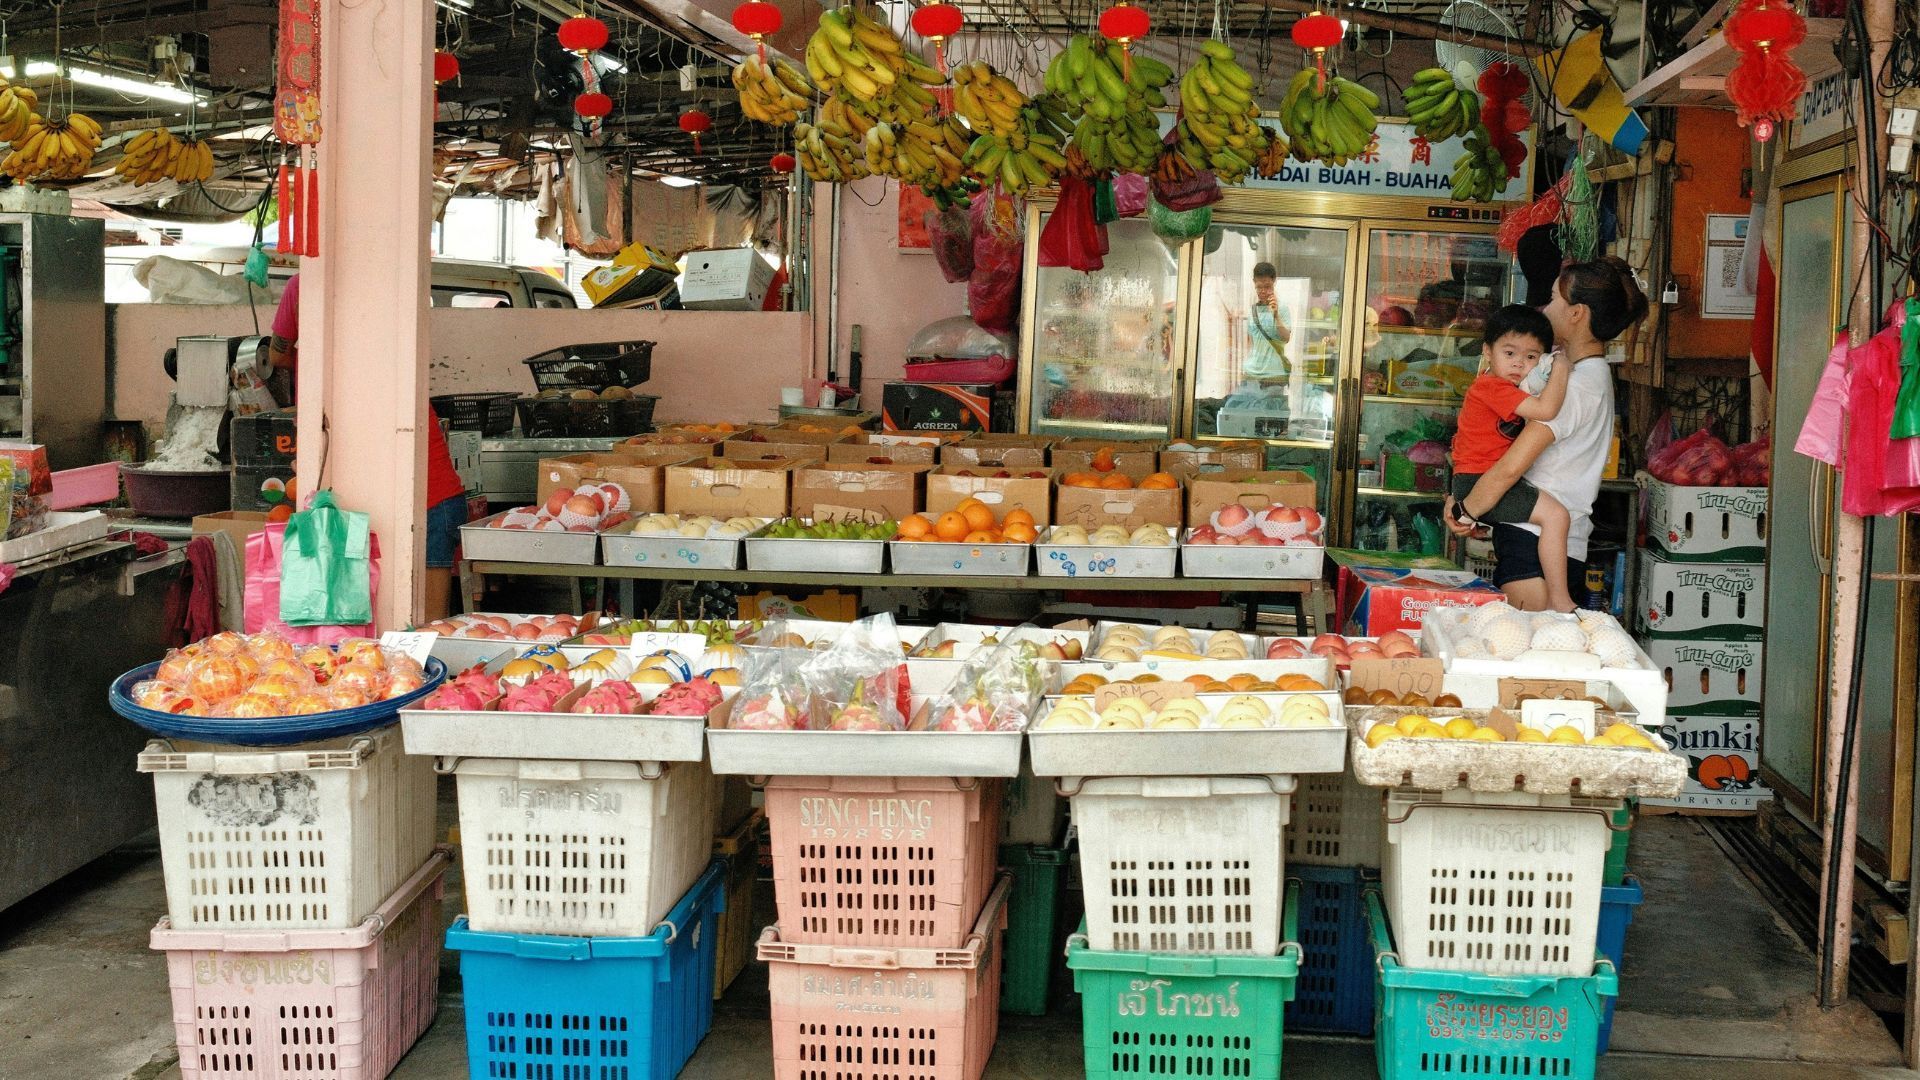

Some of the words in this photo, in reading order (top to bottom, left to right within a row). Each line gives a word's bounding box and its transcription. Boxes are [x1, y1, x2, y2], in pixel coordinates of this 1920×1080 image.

[1319, 168, 1371, 186] BUAH
[914, 422, 958, 430] AGREEN
[1676, 570, 1753, 598] Tru-Cape
[1675, 646, 1752, 673] Tru-Cape
[1674, 797, 1751, 806] ORANGE
[800, 797, 859, 827] SENG
[869, 798, 932, 830] HENG
